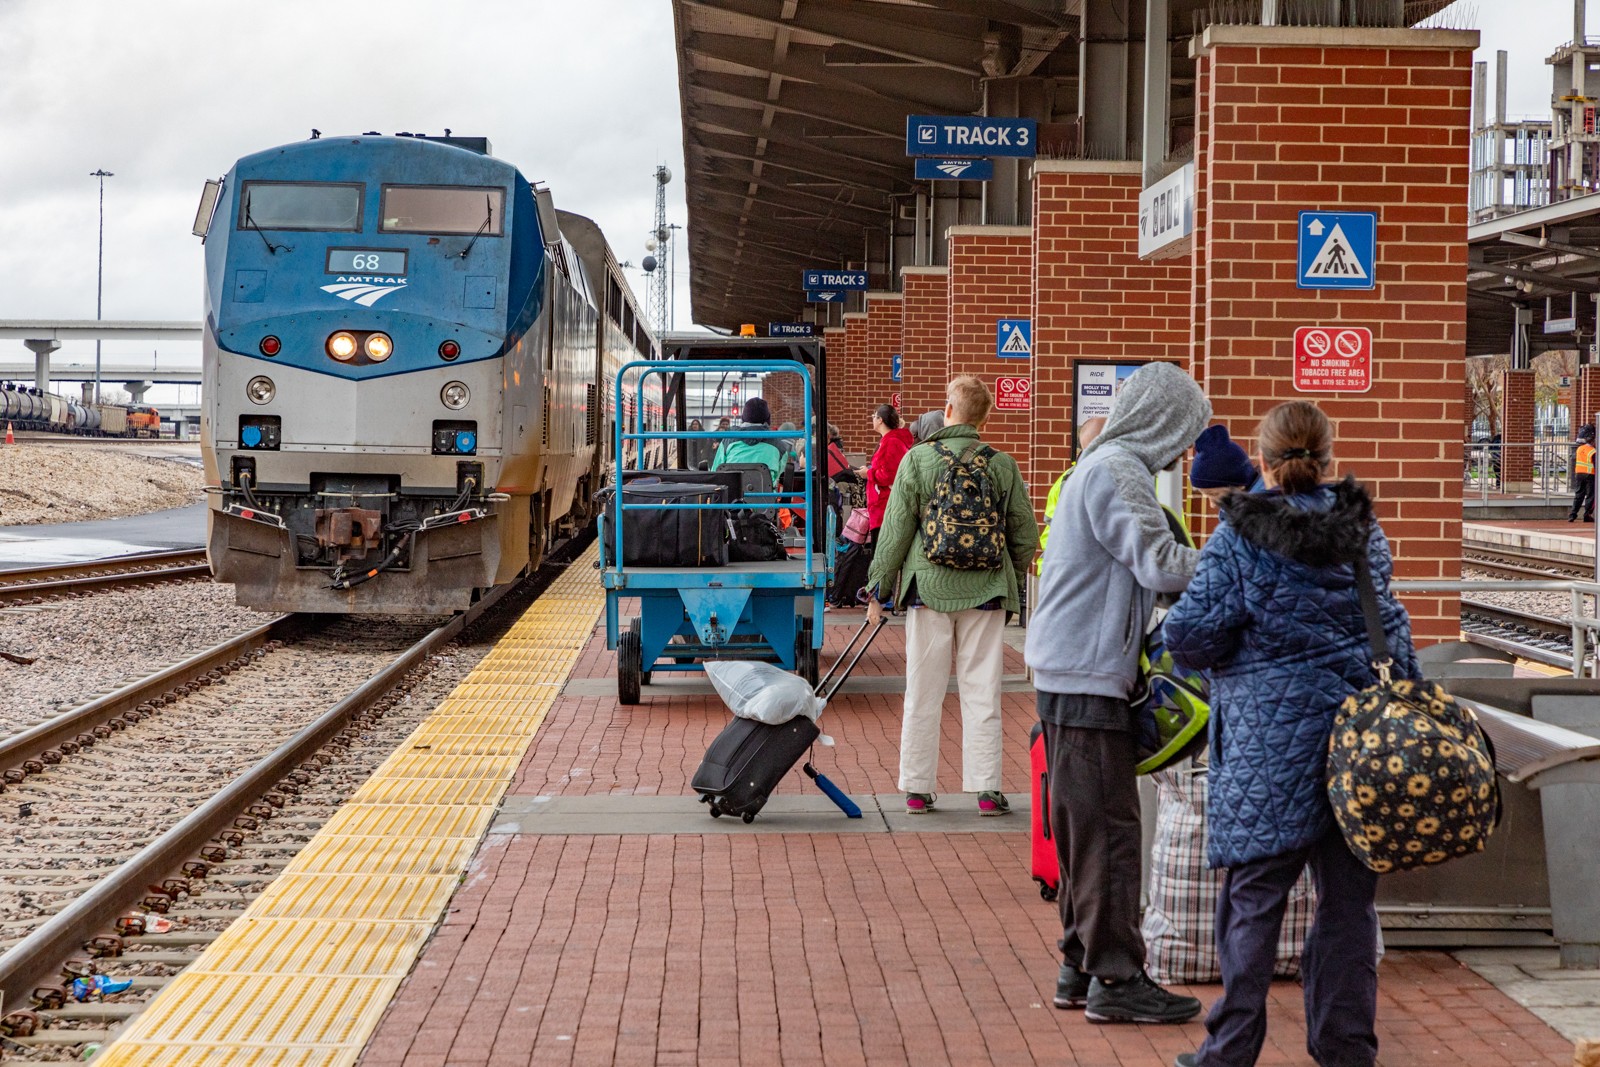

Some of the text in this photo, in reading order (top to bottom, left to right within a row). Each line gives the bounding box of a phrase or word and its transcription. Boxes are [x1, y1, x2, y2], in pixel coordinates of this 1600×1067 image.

[944, 126, 1029, 146] TRACK 3
[353, 254, 379, 270] 68
[336, 276, 407, 284] AMTRAK
[822, 275, 865, 285] TRACK 3
[1311, 359, 1320, 367] NO
[1322, 359, 1350, 367] SMOKING
[1301, 368, 1330, 376] TOBACCO
[1349, 369, 1365, 377] AREA
